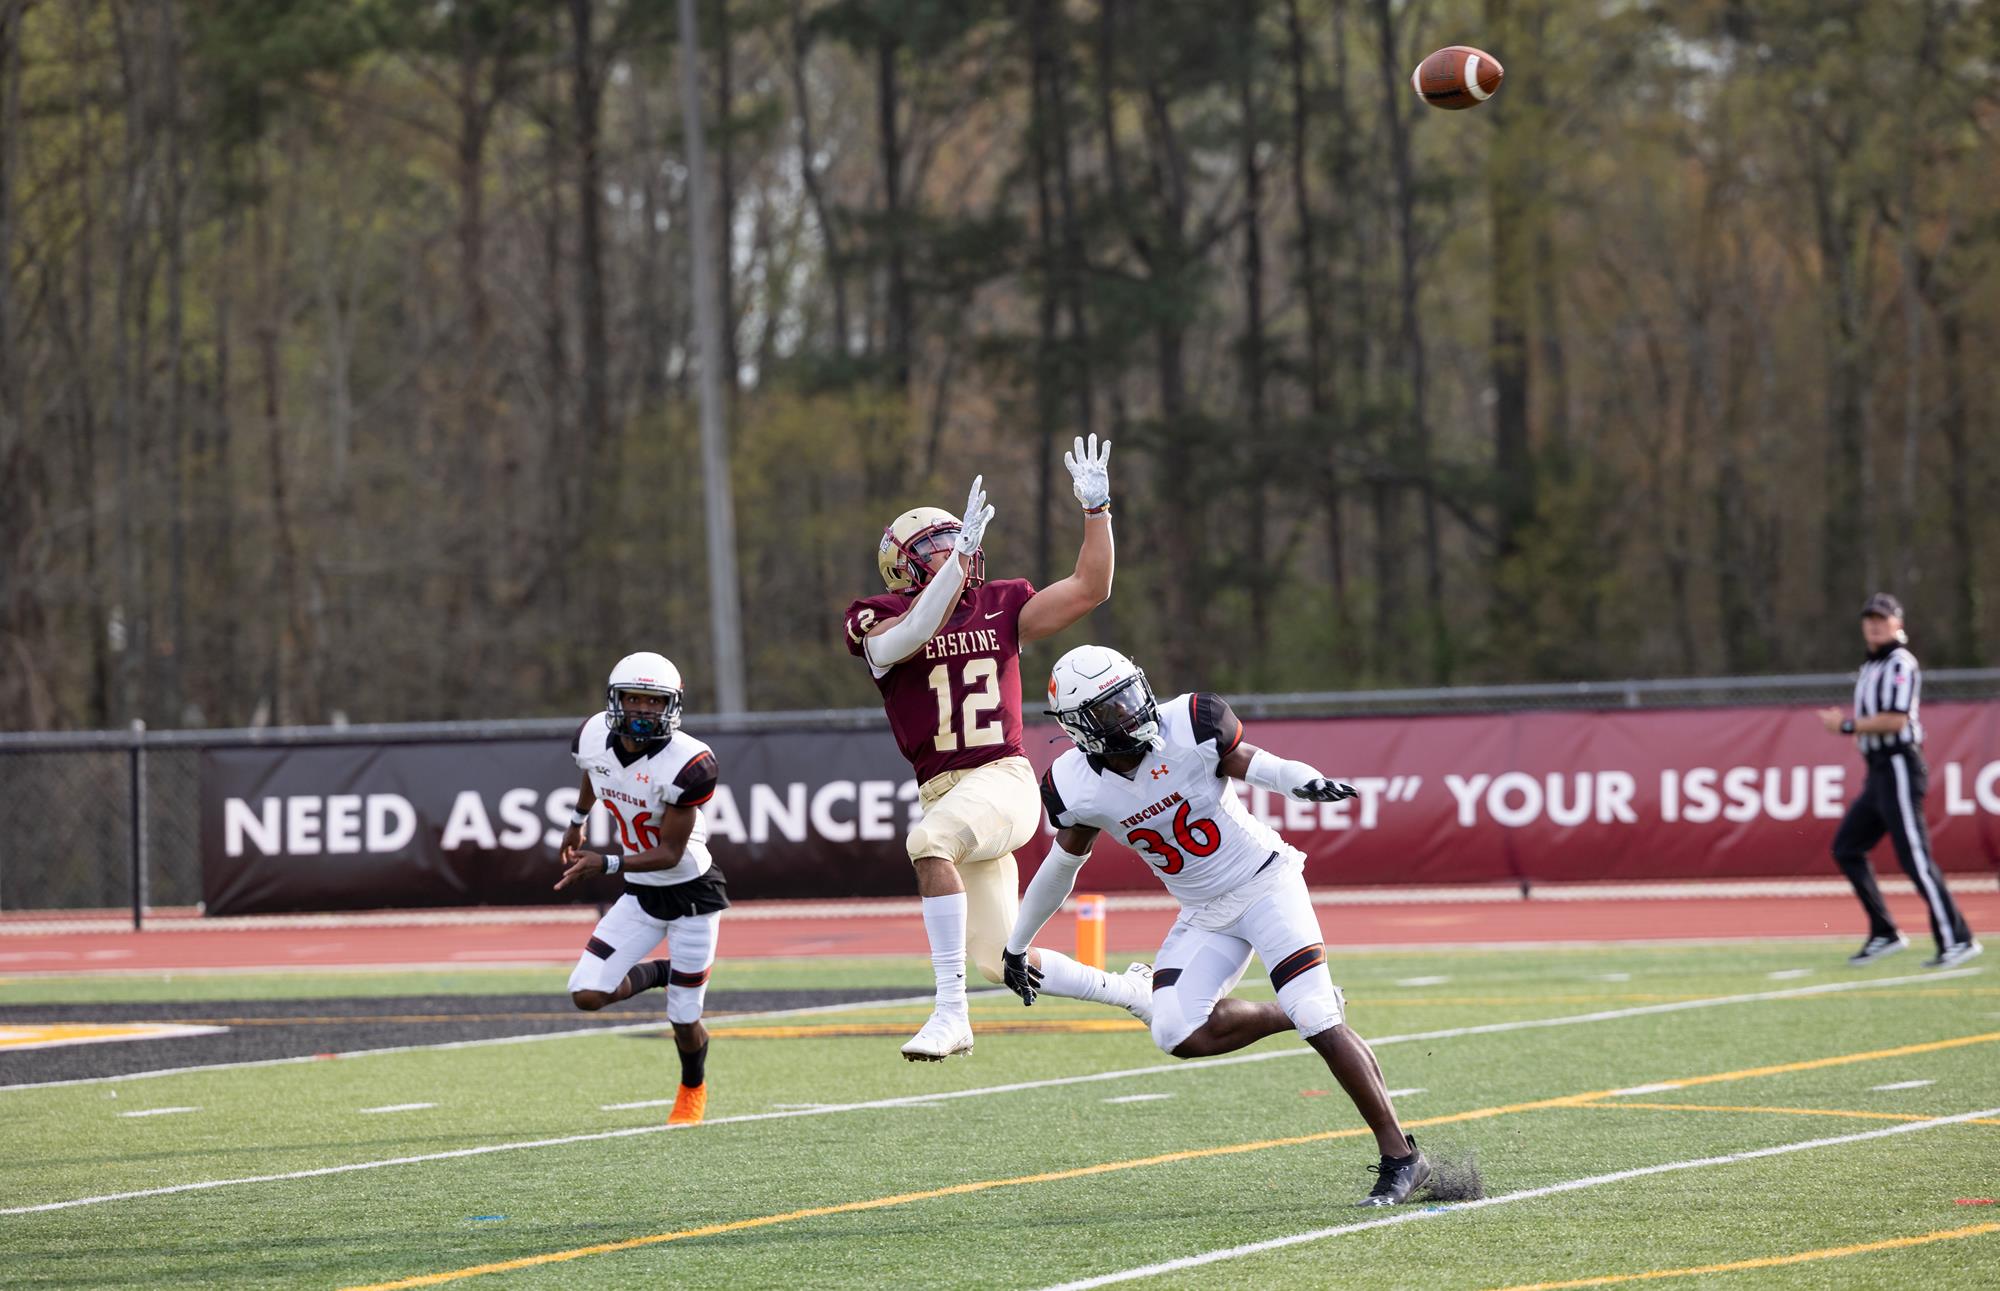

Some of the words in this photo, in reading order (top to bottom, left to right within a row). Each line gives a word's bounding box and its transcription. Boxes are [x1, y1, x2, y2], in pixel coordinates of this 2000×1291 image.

[847, 608, 878, 644] 12
[926, 629, 1000, 659] ERSKINE
[1098, 675, 1121, 691] Riddell
[928, 658, 1005, 751] 12
[224, 793, 418, 856] NEED
[440, 779, 922, 850] ASSIANCE?
[1444, 771, 1638, 828] YOUR
[1660, 765, 1846, 823] ISSUE
[600, 787, 648, 809] TUSCULUM
[1120, 791, 1184, 828] TUSCULUM
[1127, 800, 1222, 875] 36
